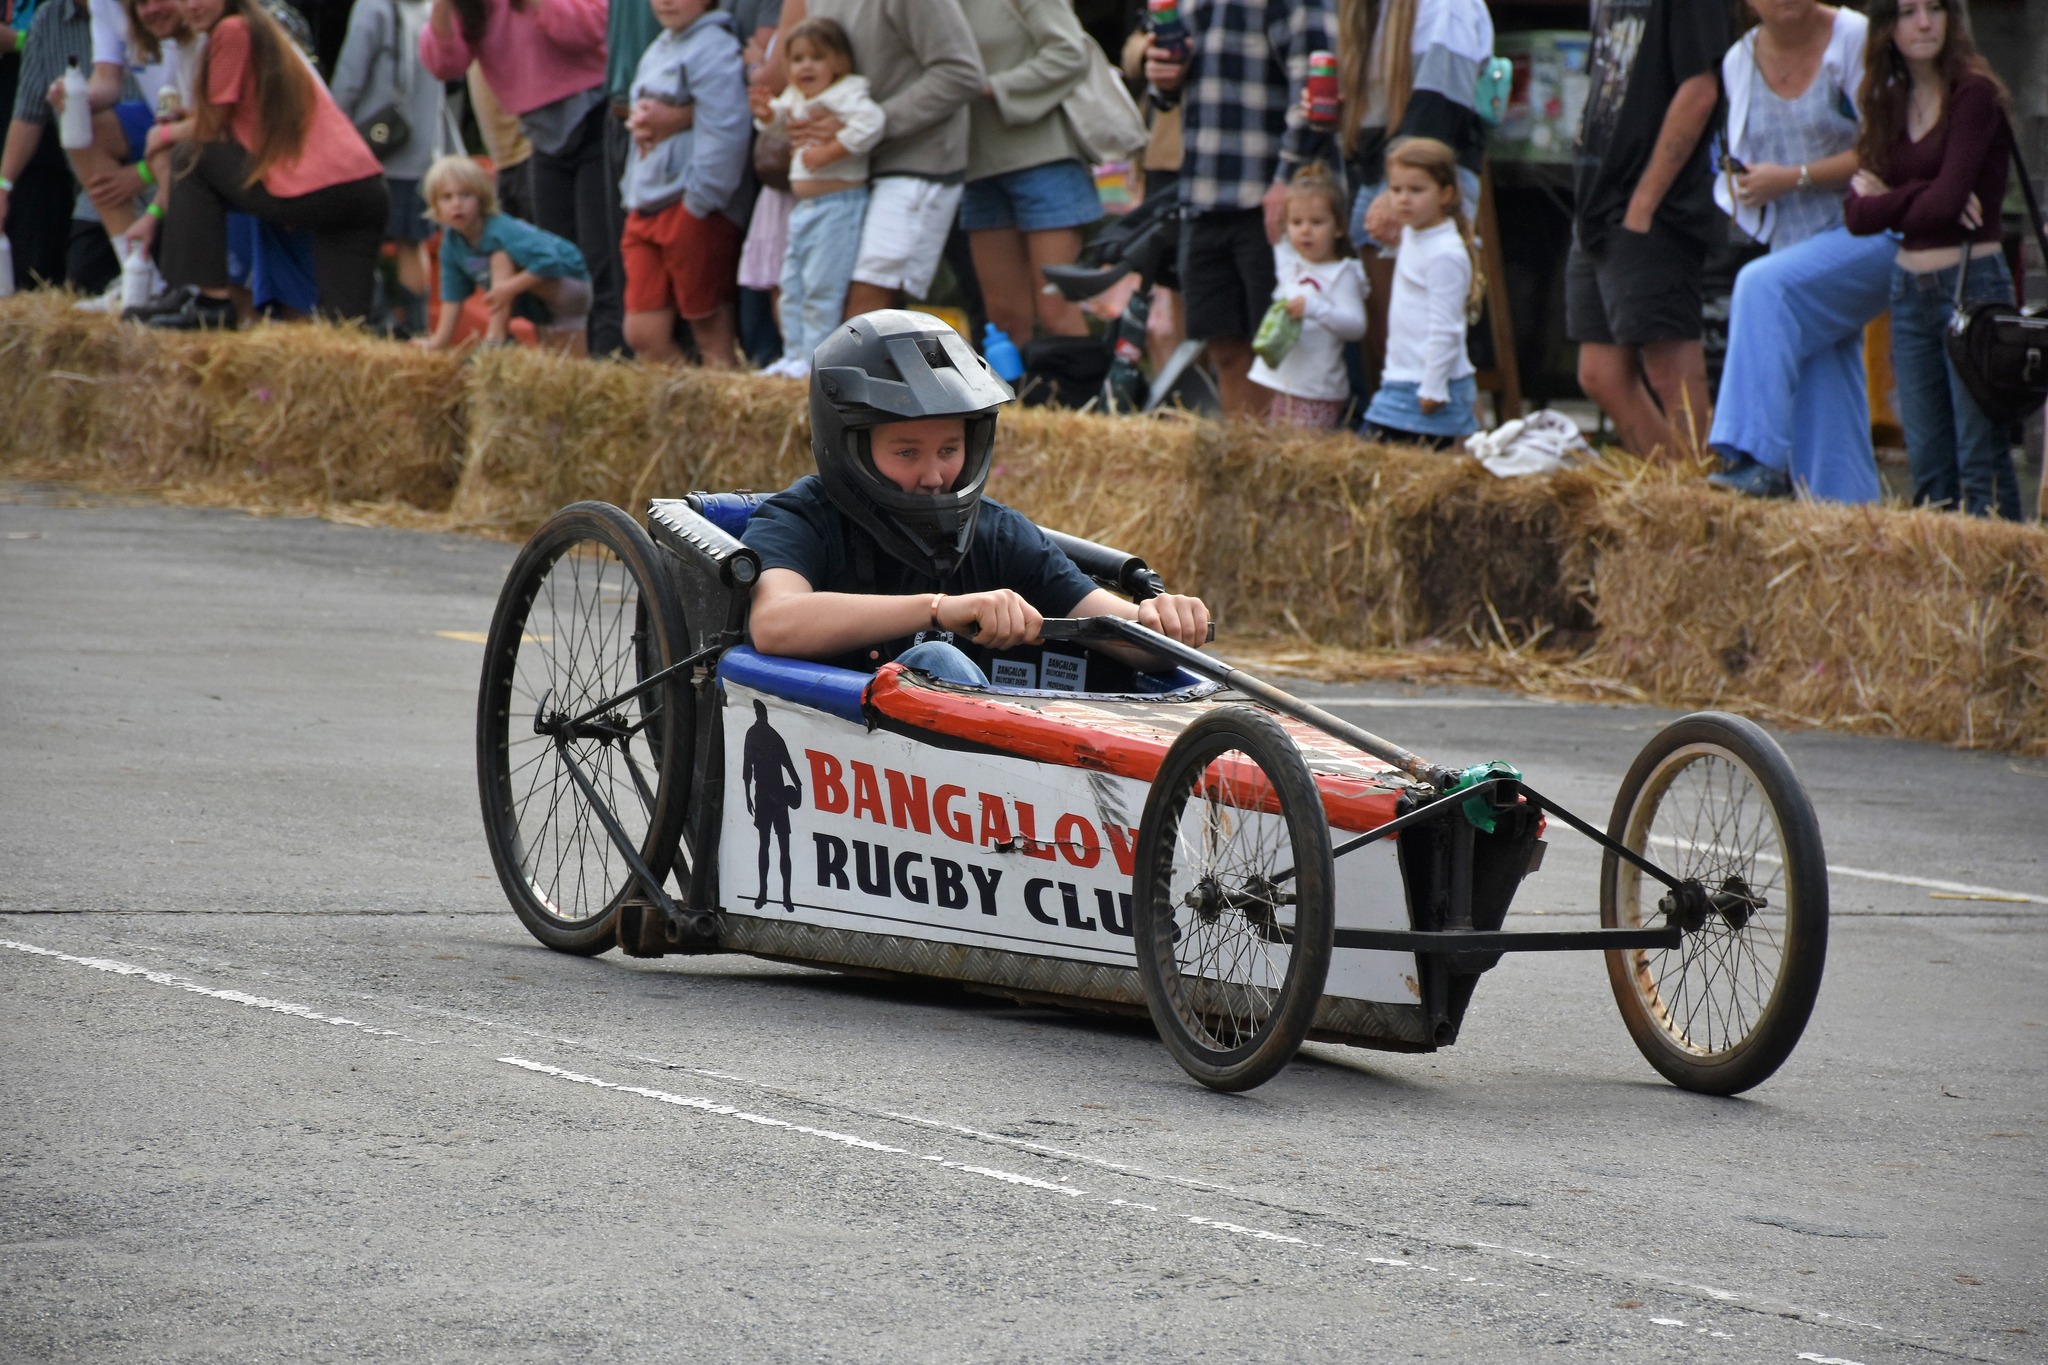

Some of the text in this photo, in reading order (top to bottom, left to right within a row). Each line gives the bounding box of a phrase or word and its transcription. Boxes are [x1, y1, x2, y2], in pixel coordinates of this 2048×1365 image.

[997, 665, 1027, 677] BANGALOW
[1048, 658, 1078, 672] BANGALOW
[813, 832, 1181, 942] RUGBY CLU
